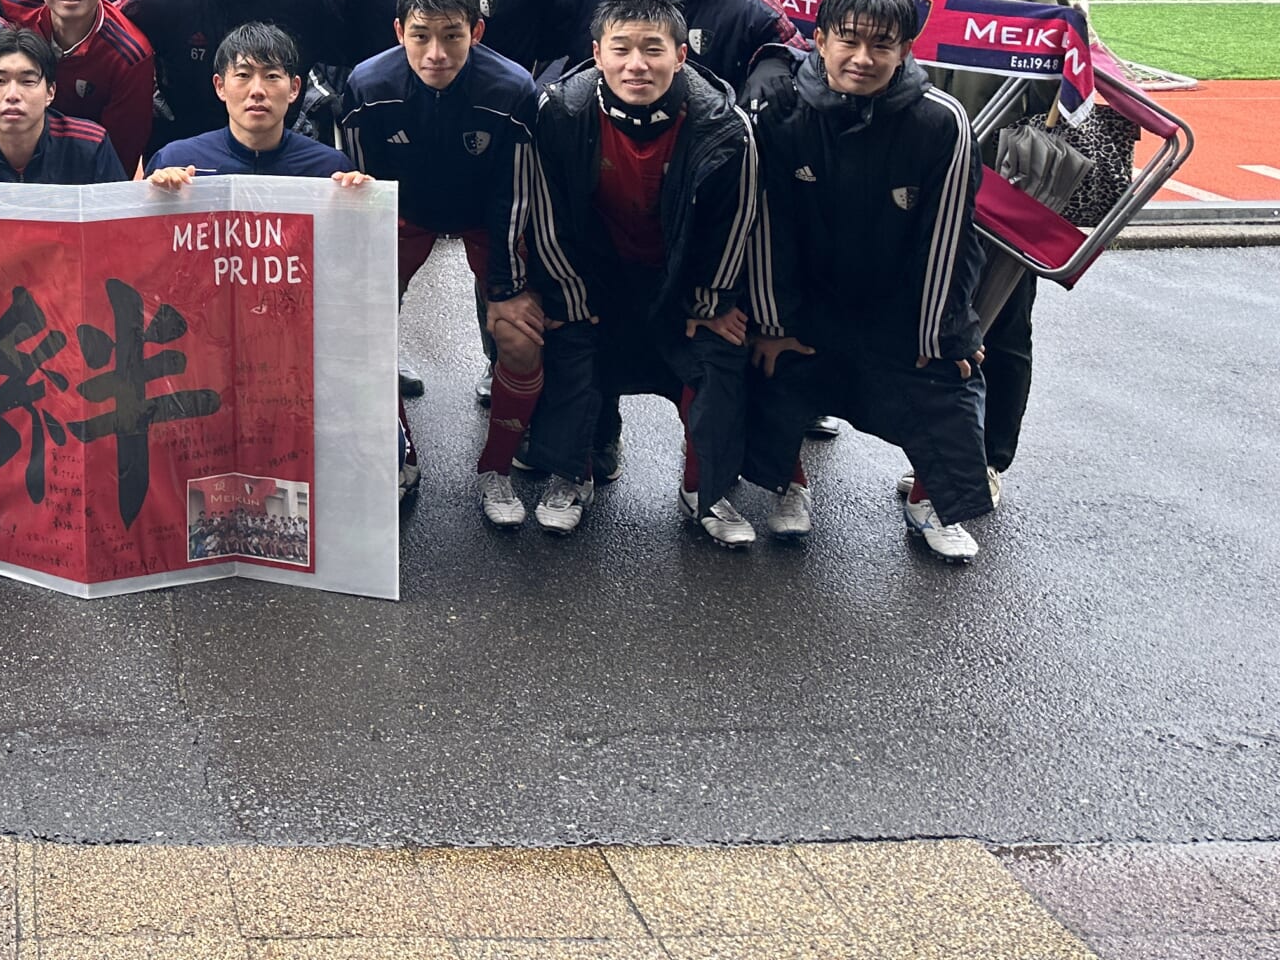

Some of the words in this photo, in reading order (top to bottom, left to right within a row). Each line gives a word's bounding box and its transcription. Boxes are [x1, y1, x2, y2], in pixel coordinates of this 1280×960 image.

[191, 48, 206, 60] 67
[1010, 56, 1059, 70] Est.1948
[173, 218, 282, 251] MEIKUN
[214, 255, 301, 286] PRIDE
[210, 494, 259, 506] MEIKUN
